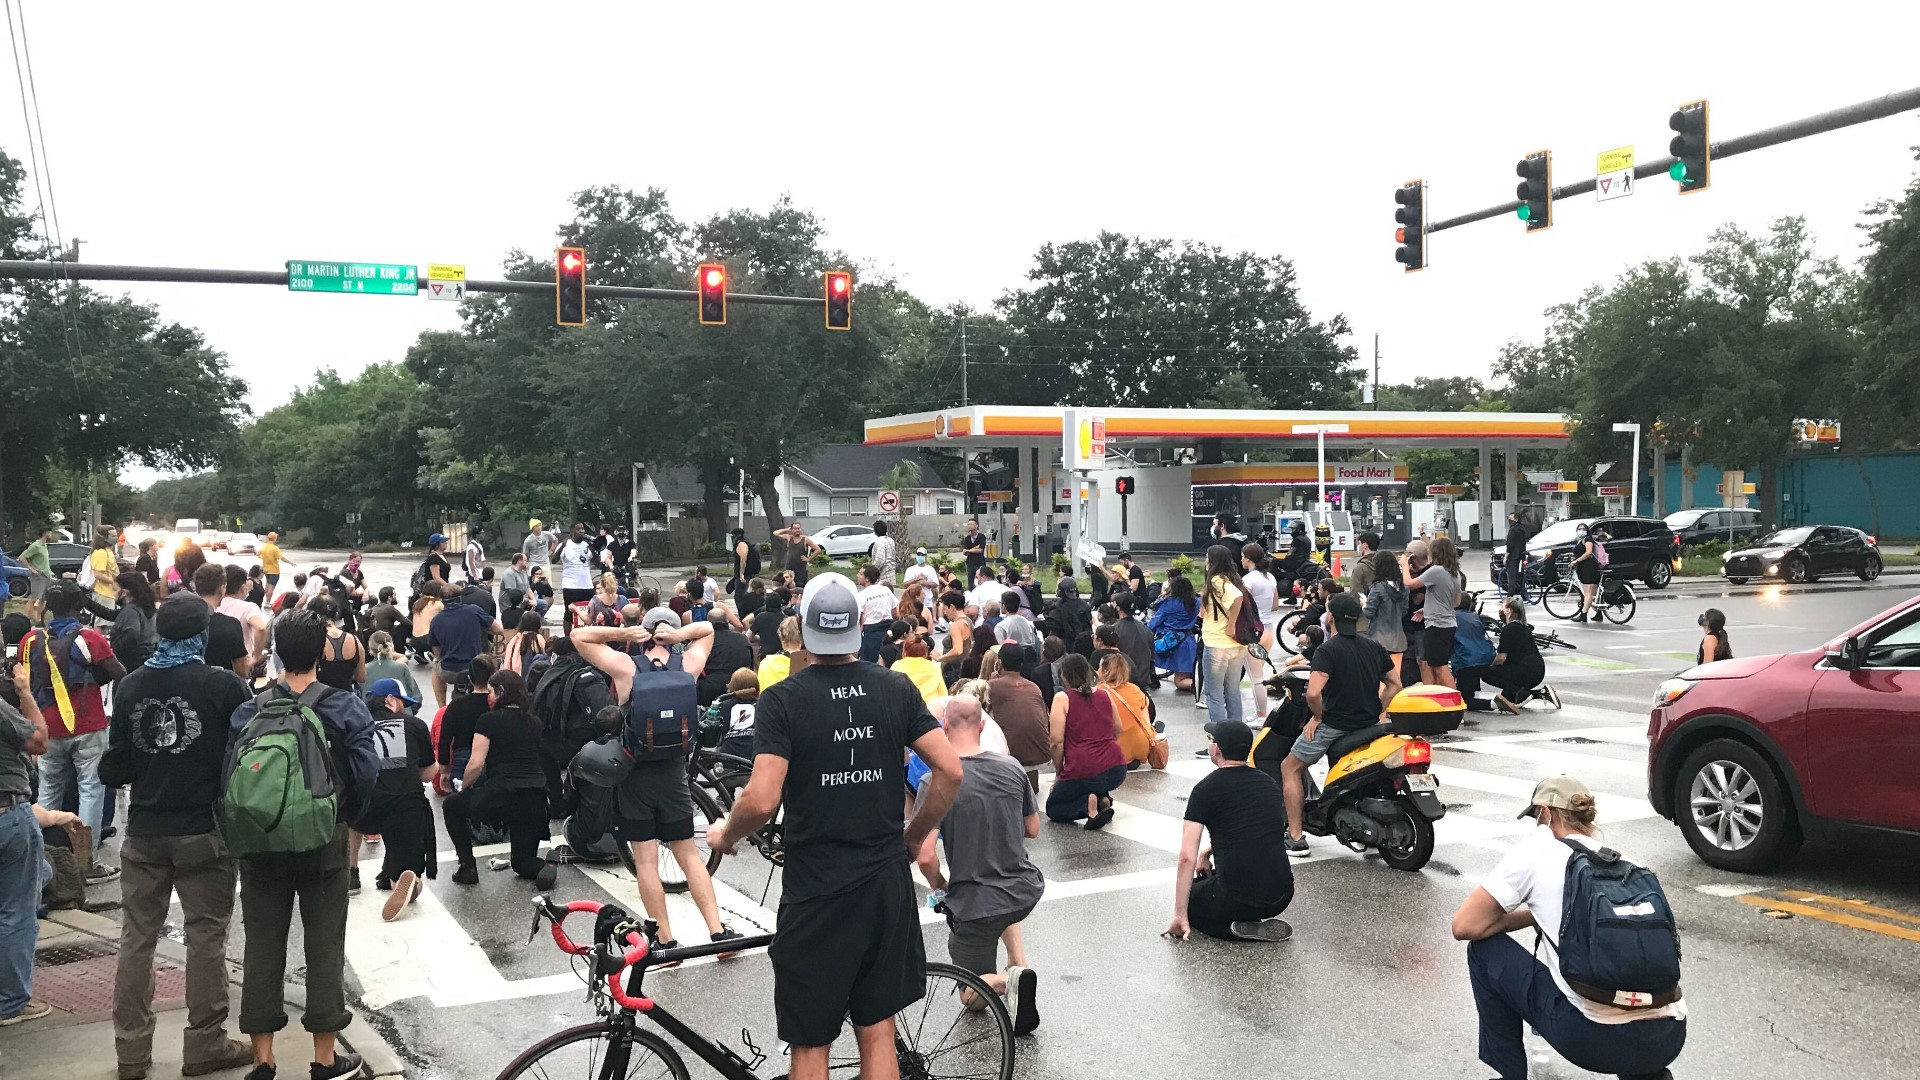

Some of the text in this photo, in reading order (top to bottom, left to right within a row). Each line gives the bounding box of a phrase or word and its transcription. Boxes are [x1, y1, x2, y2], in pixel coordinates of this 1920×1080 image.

[291, 263, 415, 280] DR MARTIN LUTHER KING JR
[291, 278, 415, 293] 2100 ST N 2200
[1339, 466, 1392, 478] Food Mart
[1194, 490, 1204, 498] GO
[830, 684, 867, 700] HEAL
[833, 725, 874, 742] MOVE
[821, 767, 883, 787] PERFORM
